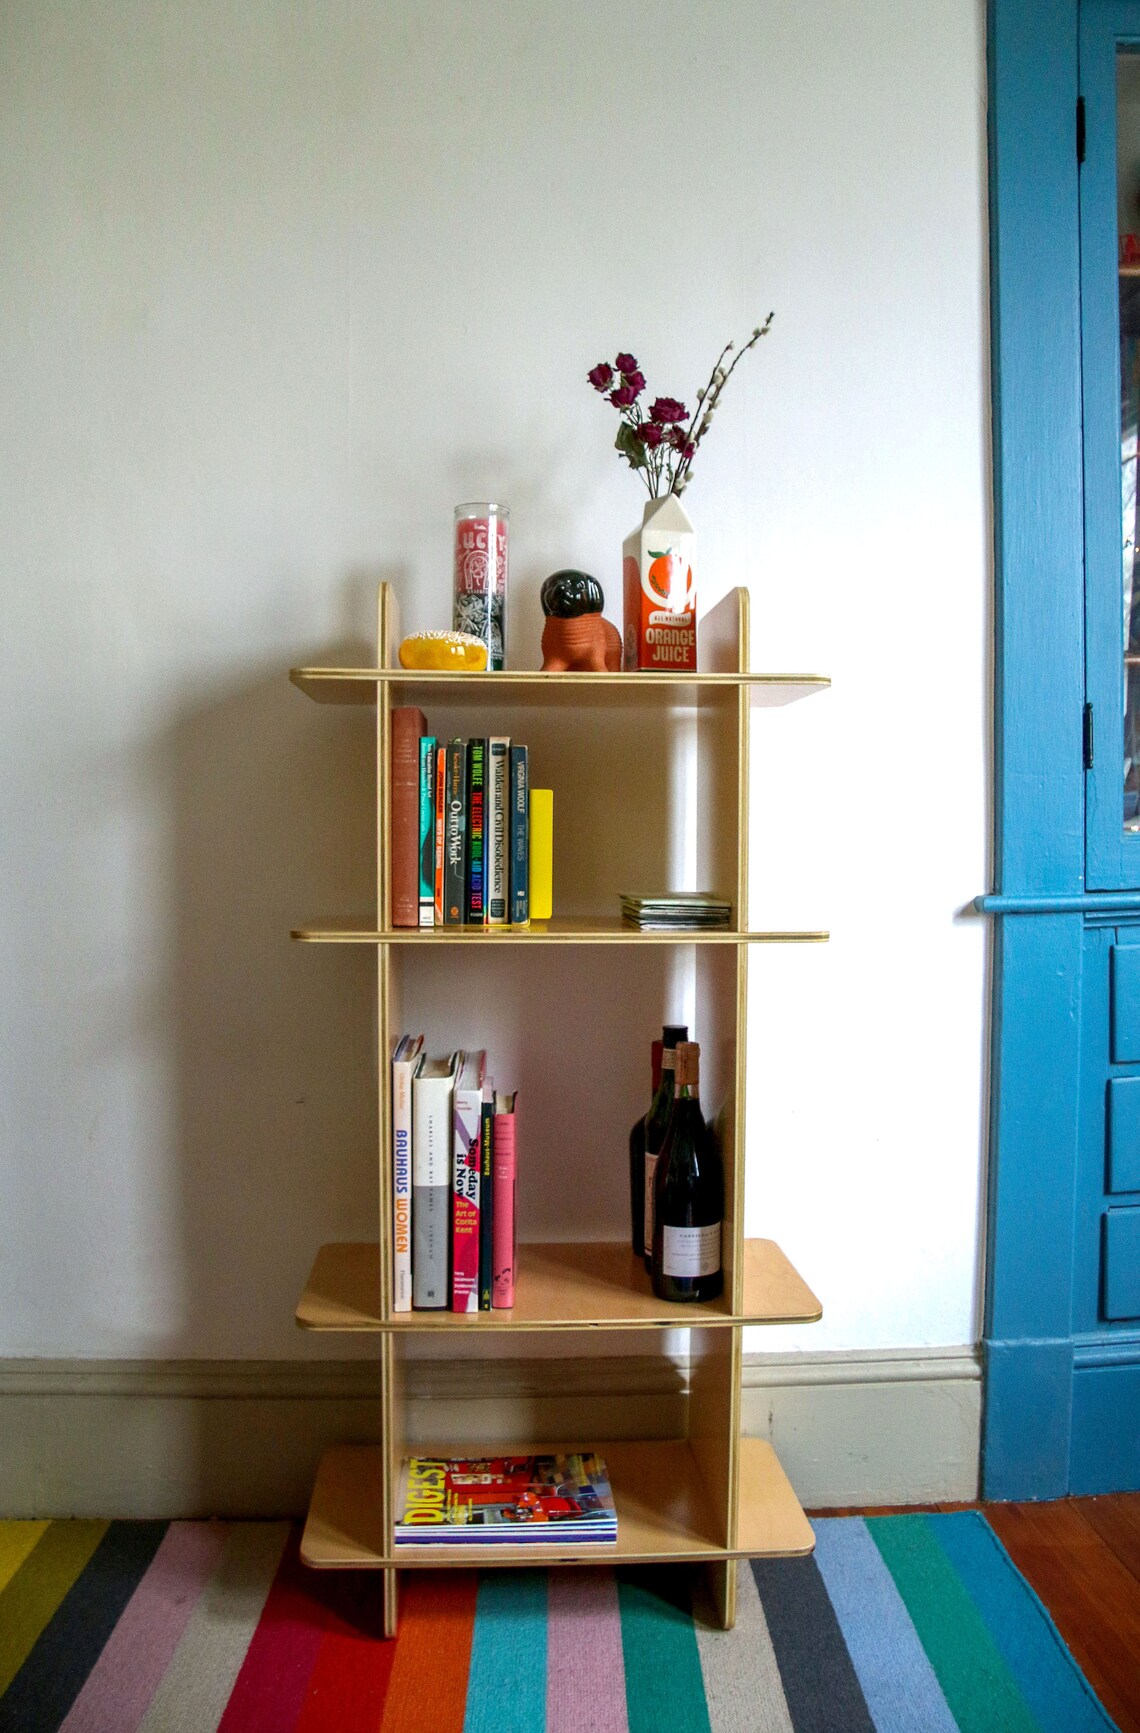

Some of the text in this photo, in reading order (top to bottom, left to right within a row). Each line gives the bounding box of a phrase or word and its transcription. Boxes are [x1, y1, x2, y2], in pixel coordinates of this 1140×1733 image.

[645, 627, 695, 646] ORANGE
[652, 645, 690, 662] JUICE
[472, 746, 483, 786] TOM WOLFE
[494, 760, 505, 792] Walden
[472, 792, 483, 805] THE
[494, 794, 505, 811] and
[517, 761, 525, 814] VIRGINIA WOOLF
[450, 800, 462, 864] Out to Work
[472, 807, 483, 839] ELECTRIC
[494, 812, 505, 833] Civil
[472, 841, 483, 872] KOOL-AID
[517, 824, 525, 861] THE WAVES
[494, 834, 505, 893] Disobedience
[472, 874, 483, 892] ACID
[472, 892, 482, 909] TEST
[456, 1153, 466, 1200] is Now
[466, 1138, 479, 1200] Someday
[396, 1129, 408, 1253] BAUHAUS WOMEN
[403, 1458, 446, 1524] DIGEST
